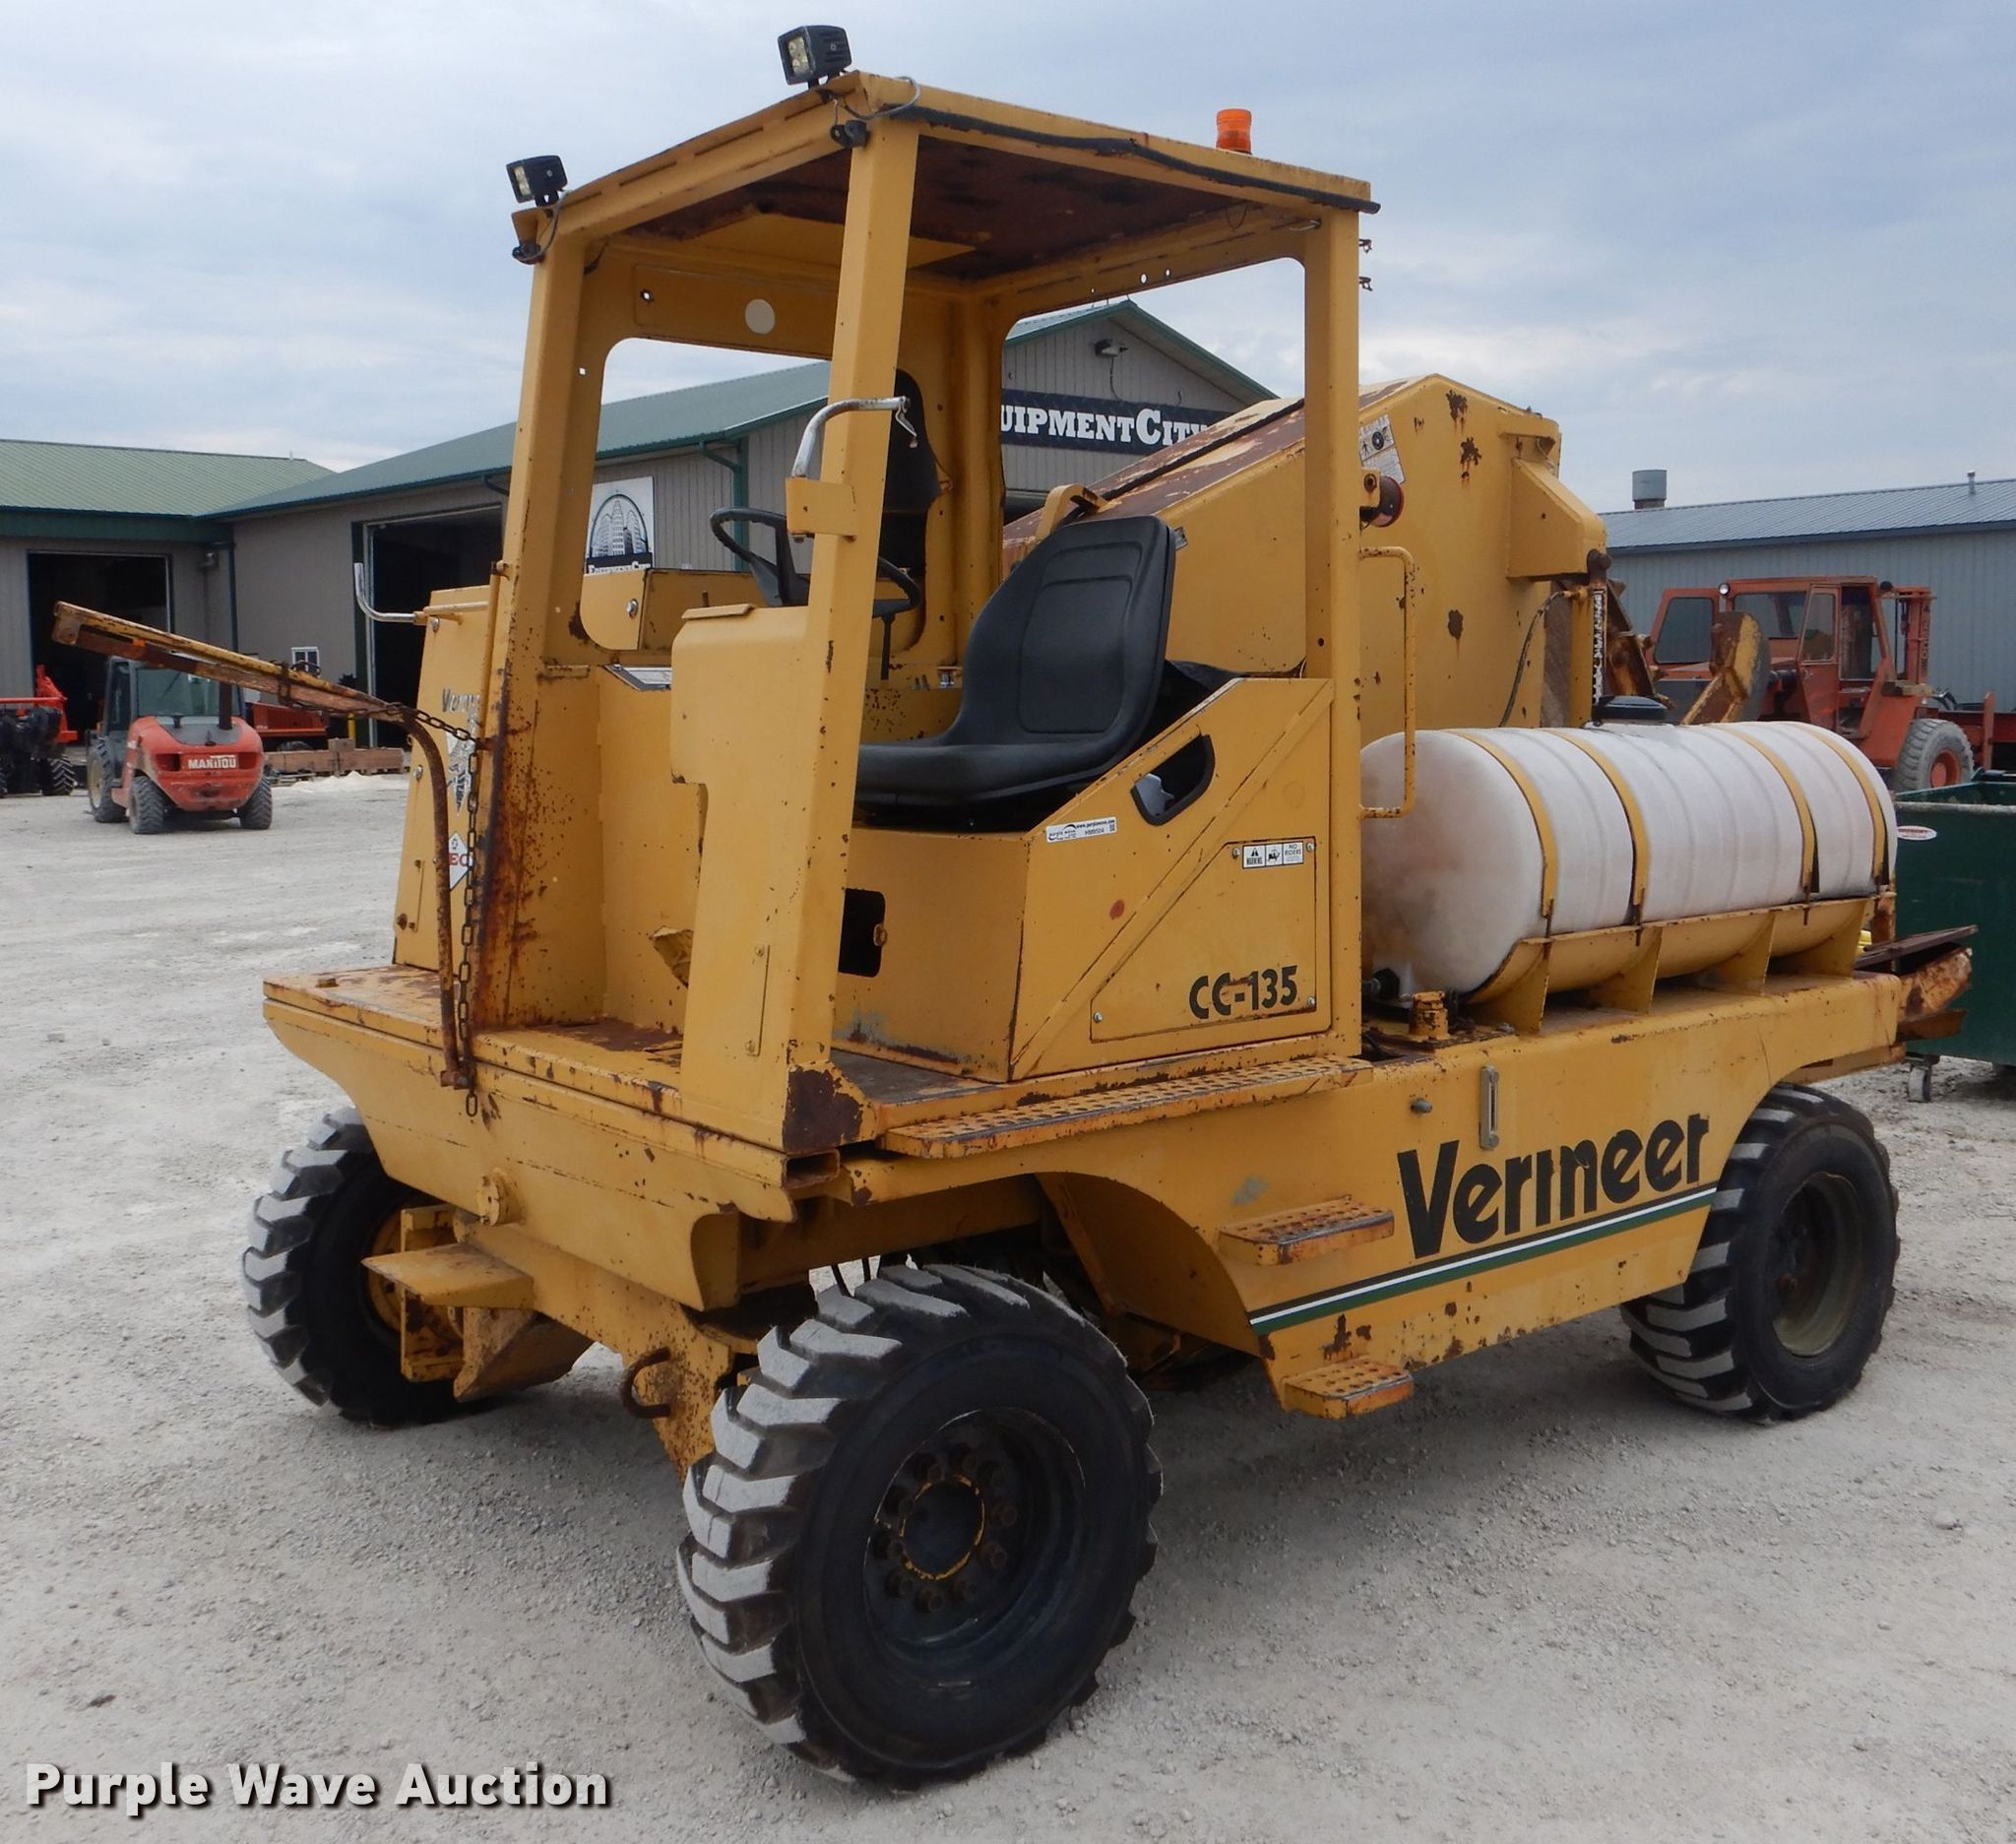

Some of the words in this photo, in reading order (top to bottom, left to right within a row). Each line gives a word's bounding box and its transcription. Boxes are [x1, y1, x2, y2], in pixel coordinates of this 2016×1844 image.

[188, 755, 236, 769] MANITOU
[1189, 965, 1297, 1019] CC-135
[1397, 1113, 1709, 1259] Vermeer
